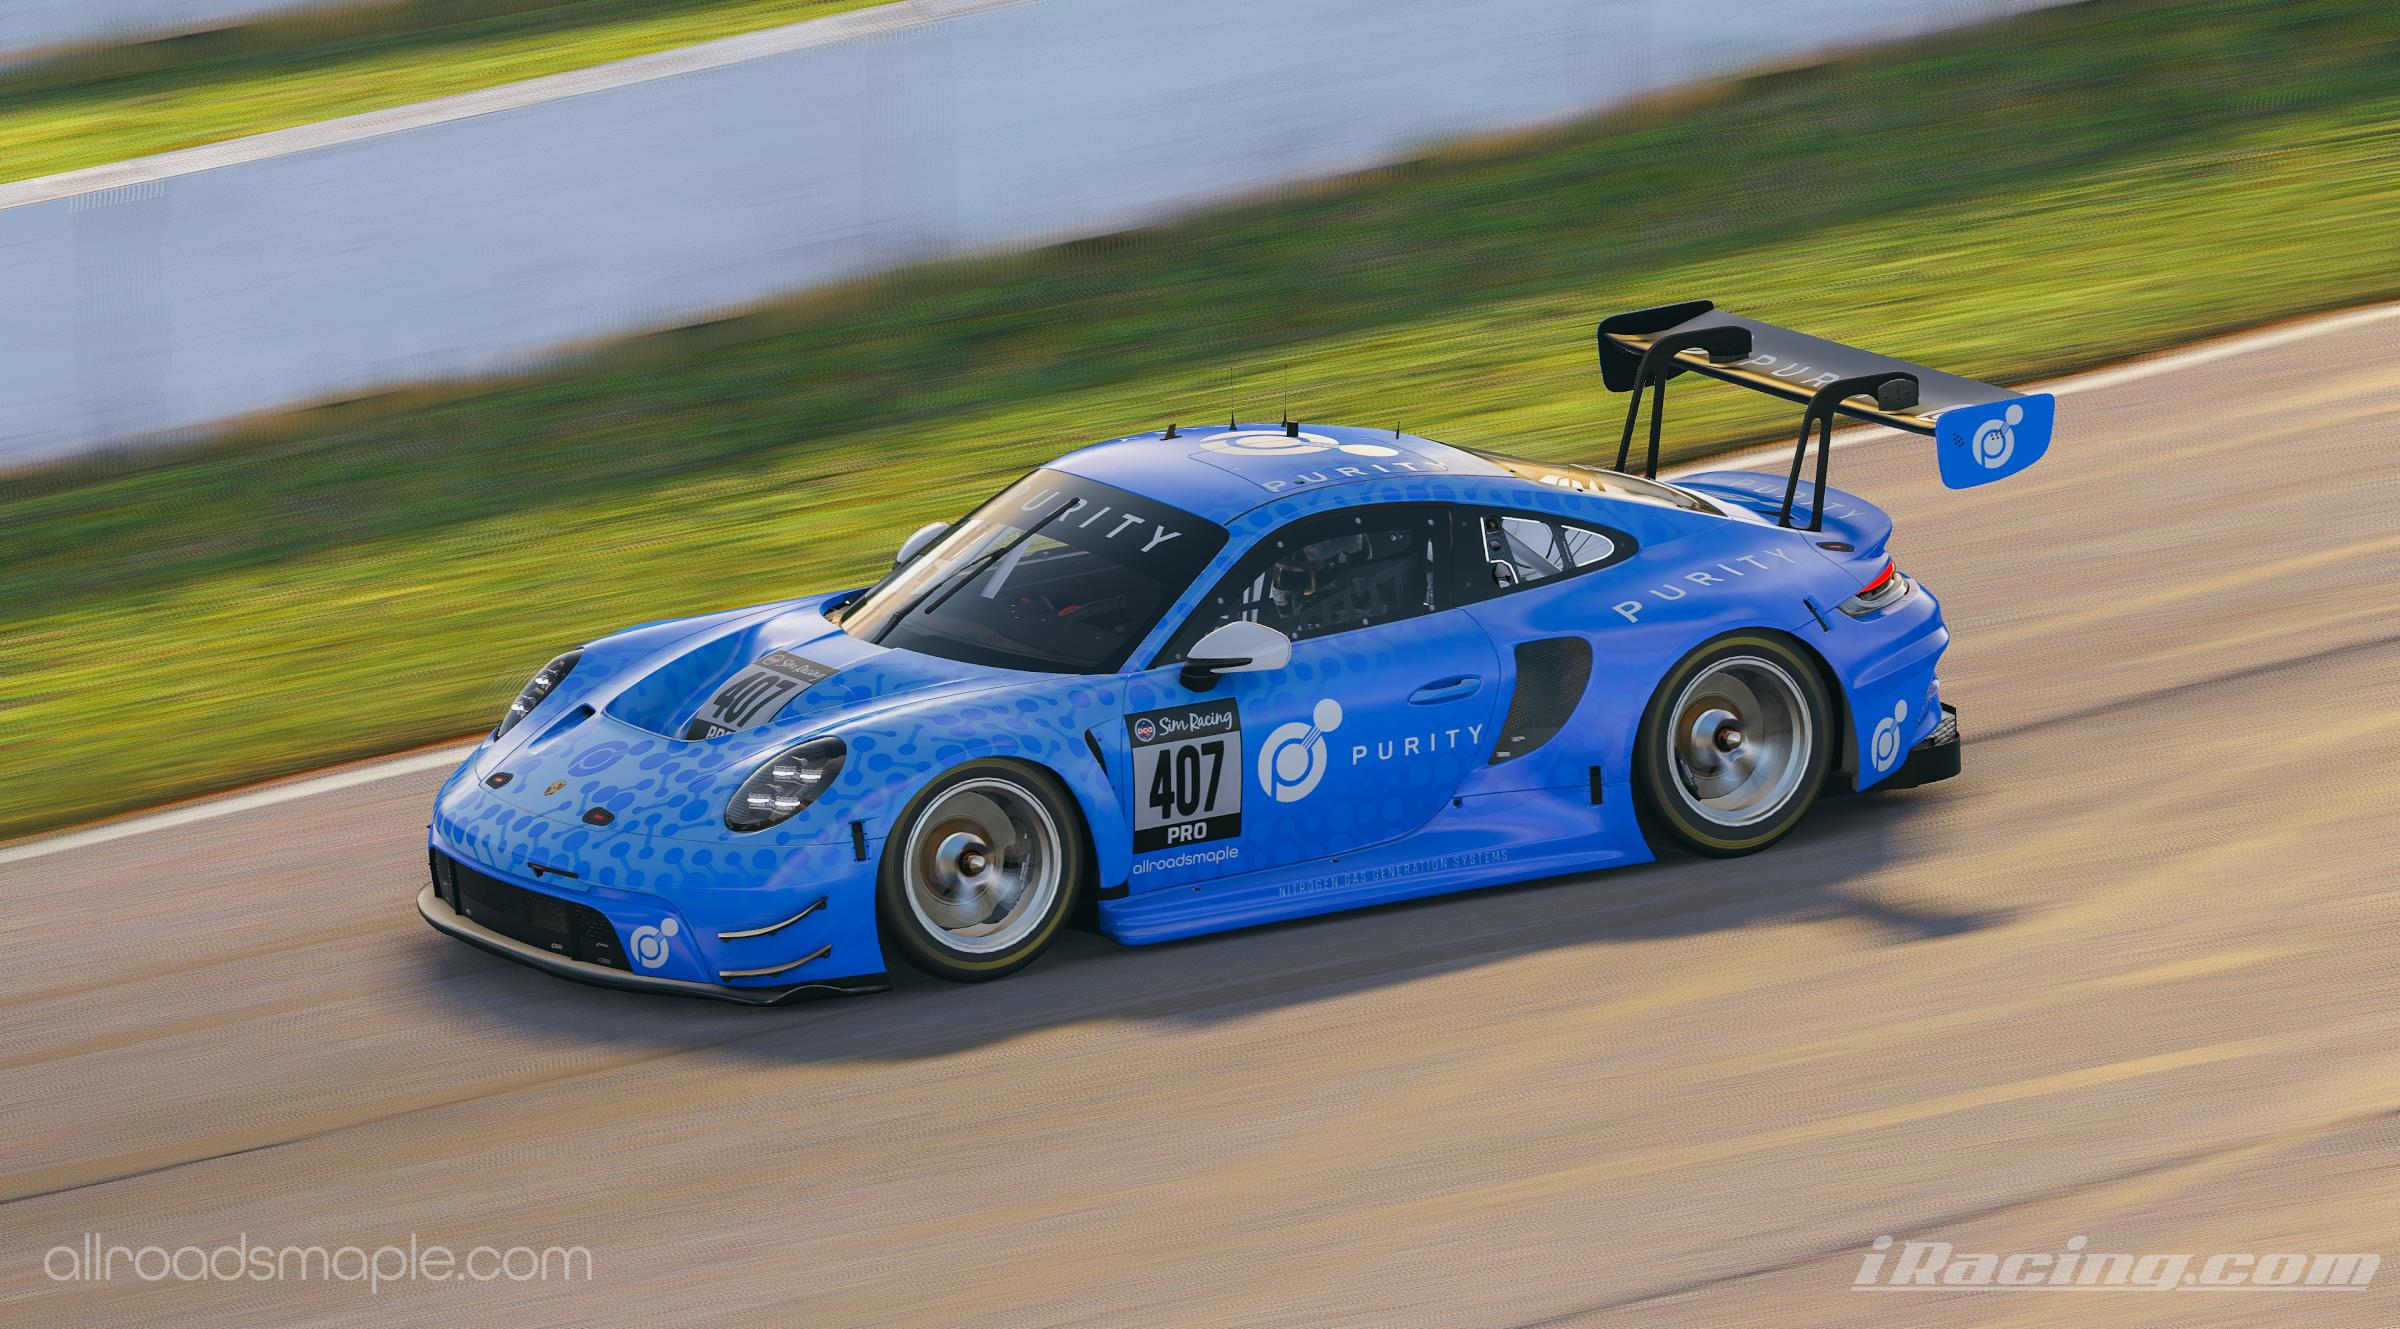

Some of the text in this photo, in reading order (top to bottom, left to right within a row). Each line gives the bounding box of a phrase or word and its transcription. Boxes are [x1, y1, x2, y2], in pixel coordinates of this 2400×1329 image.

[1262, 462, 1448, 493] PURITY
[1611, 547, 1796, 623] PURITY
[712, 671, 798, 727] 407
[705, 726, 736, 739] PR
[1159, 717, 1188, 736] Sim
[1189, 711, 1232, 732] Racing
[1352, 724, 1484, 765] PURITY
[1149, 740, 1224, 819] 407
[1167, 821, 1207, 844] PRO
[1132, 845, 1239, 875] allroadsmaple
[1279, 849, 1508, 898] NITROGEN GAS GENERATION SYSTEMS
